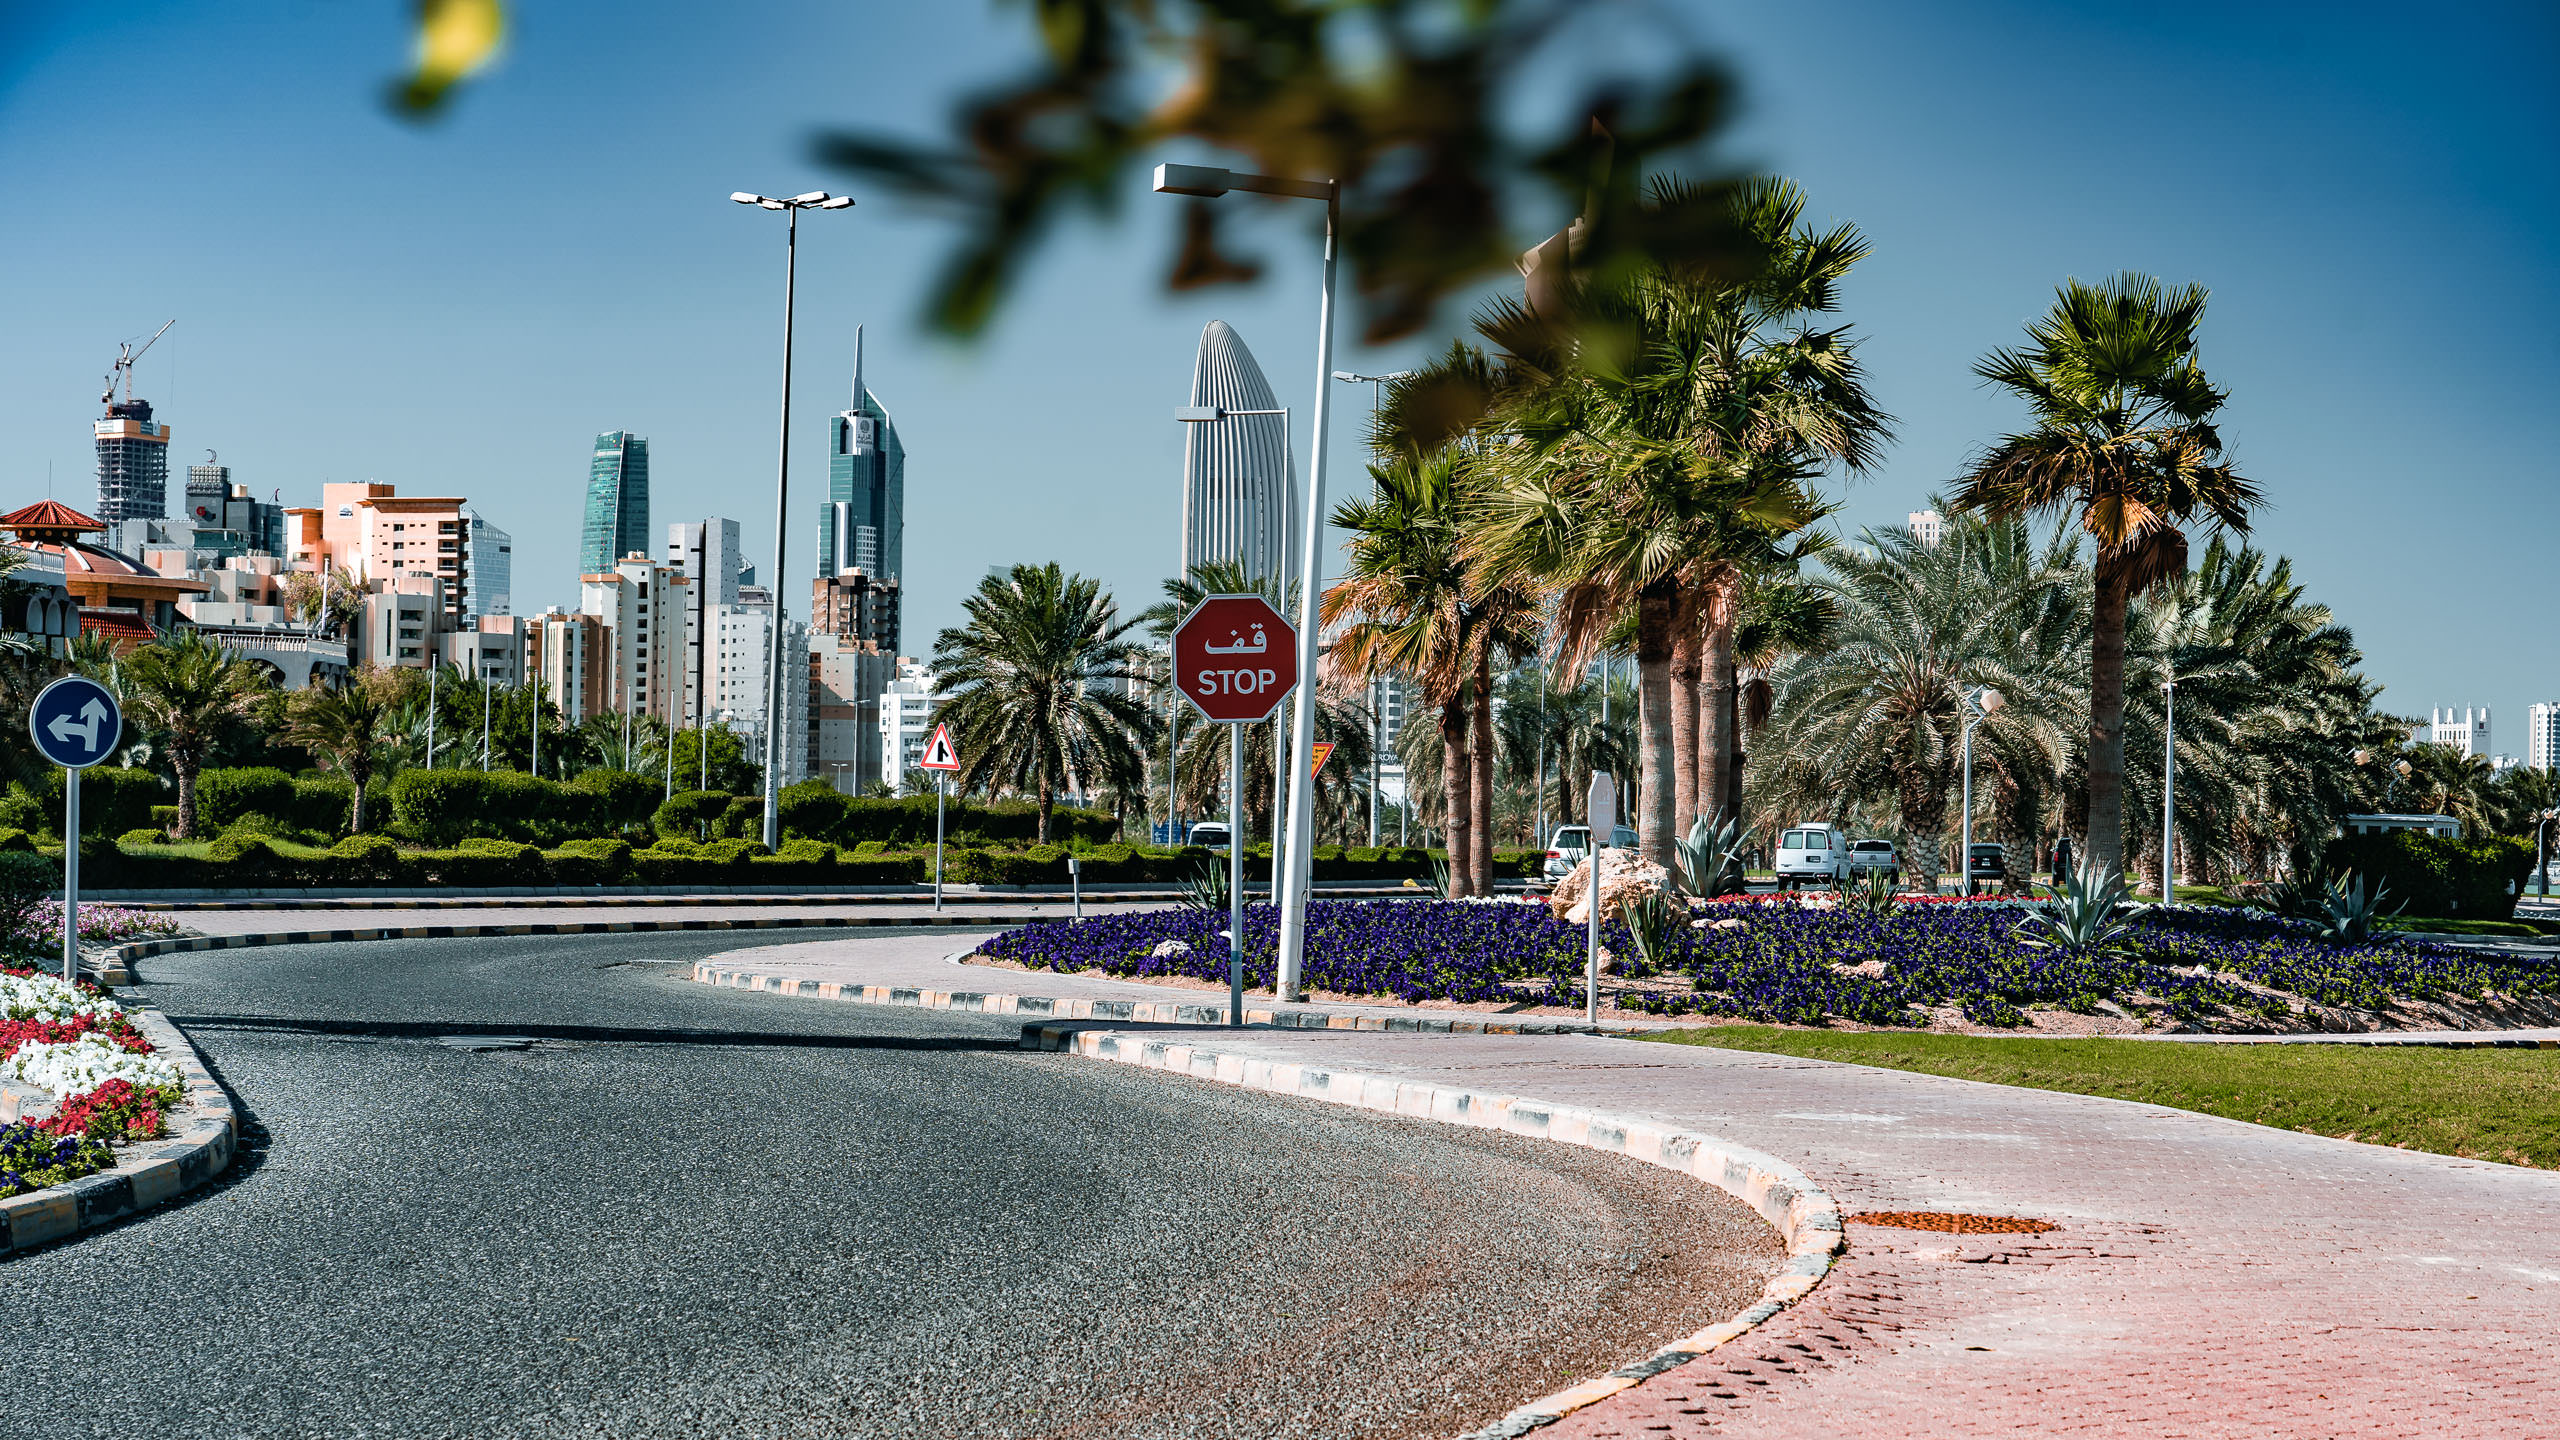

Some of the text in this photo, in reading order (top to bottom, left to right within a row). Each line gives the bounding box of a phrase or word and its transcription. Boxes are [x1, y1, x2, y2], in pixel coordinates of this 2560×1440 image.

[1204, 622, 1268, 655] قف
[1198, 668, 1277, 696] STOP
[1378, 753, 1401, 762] ROYA
